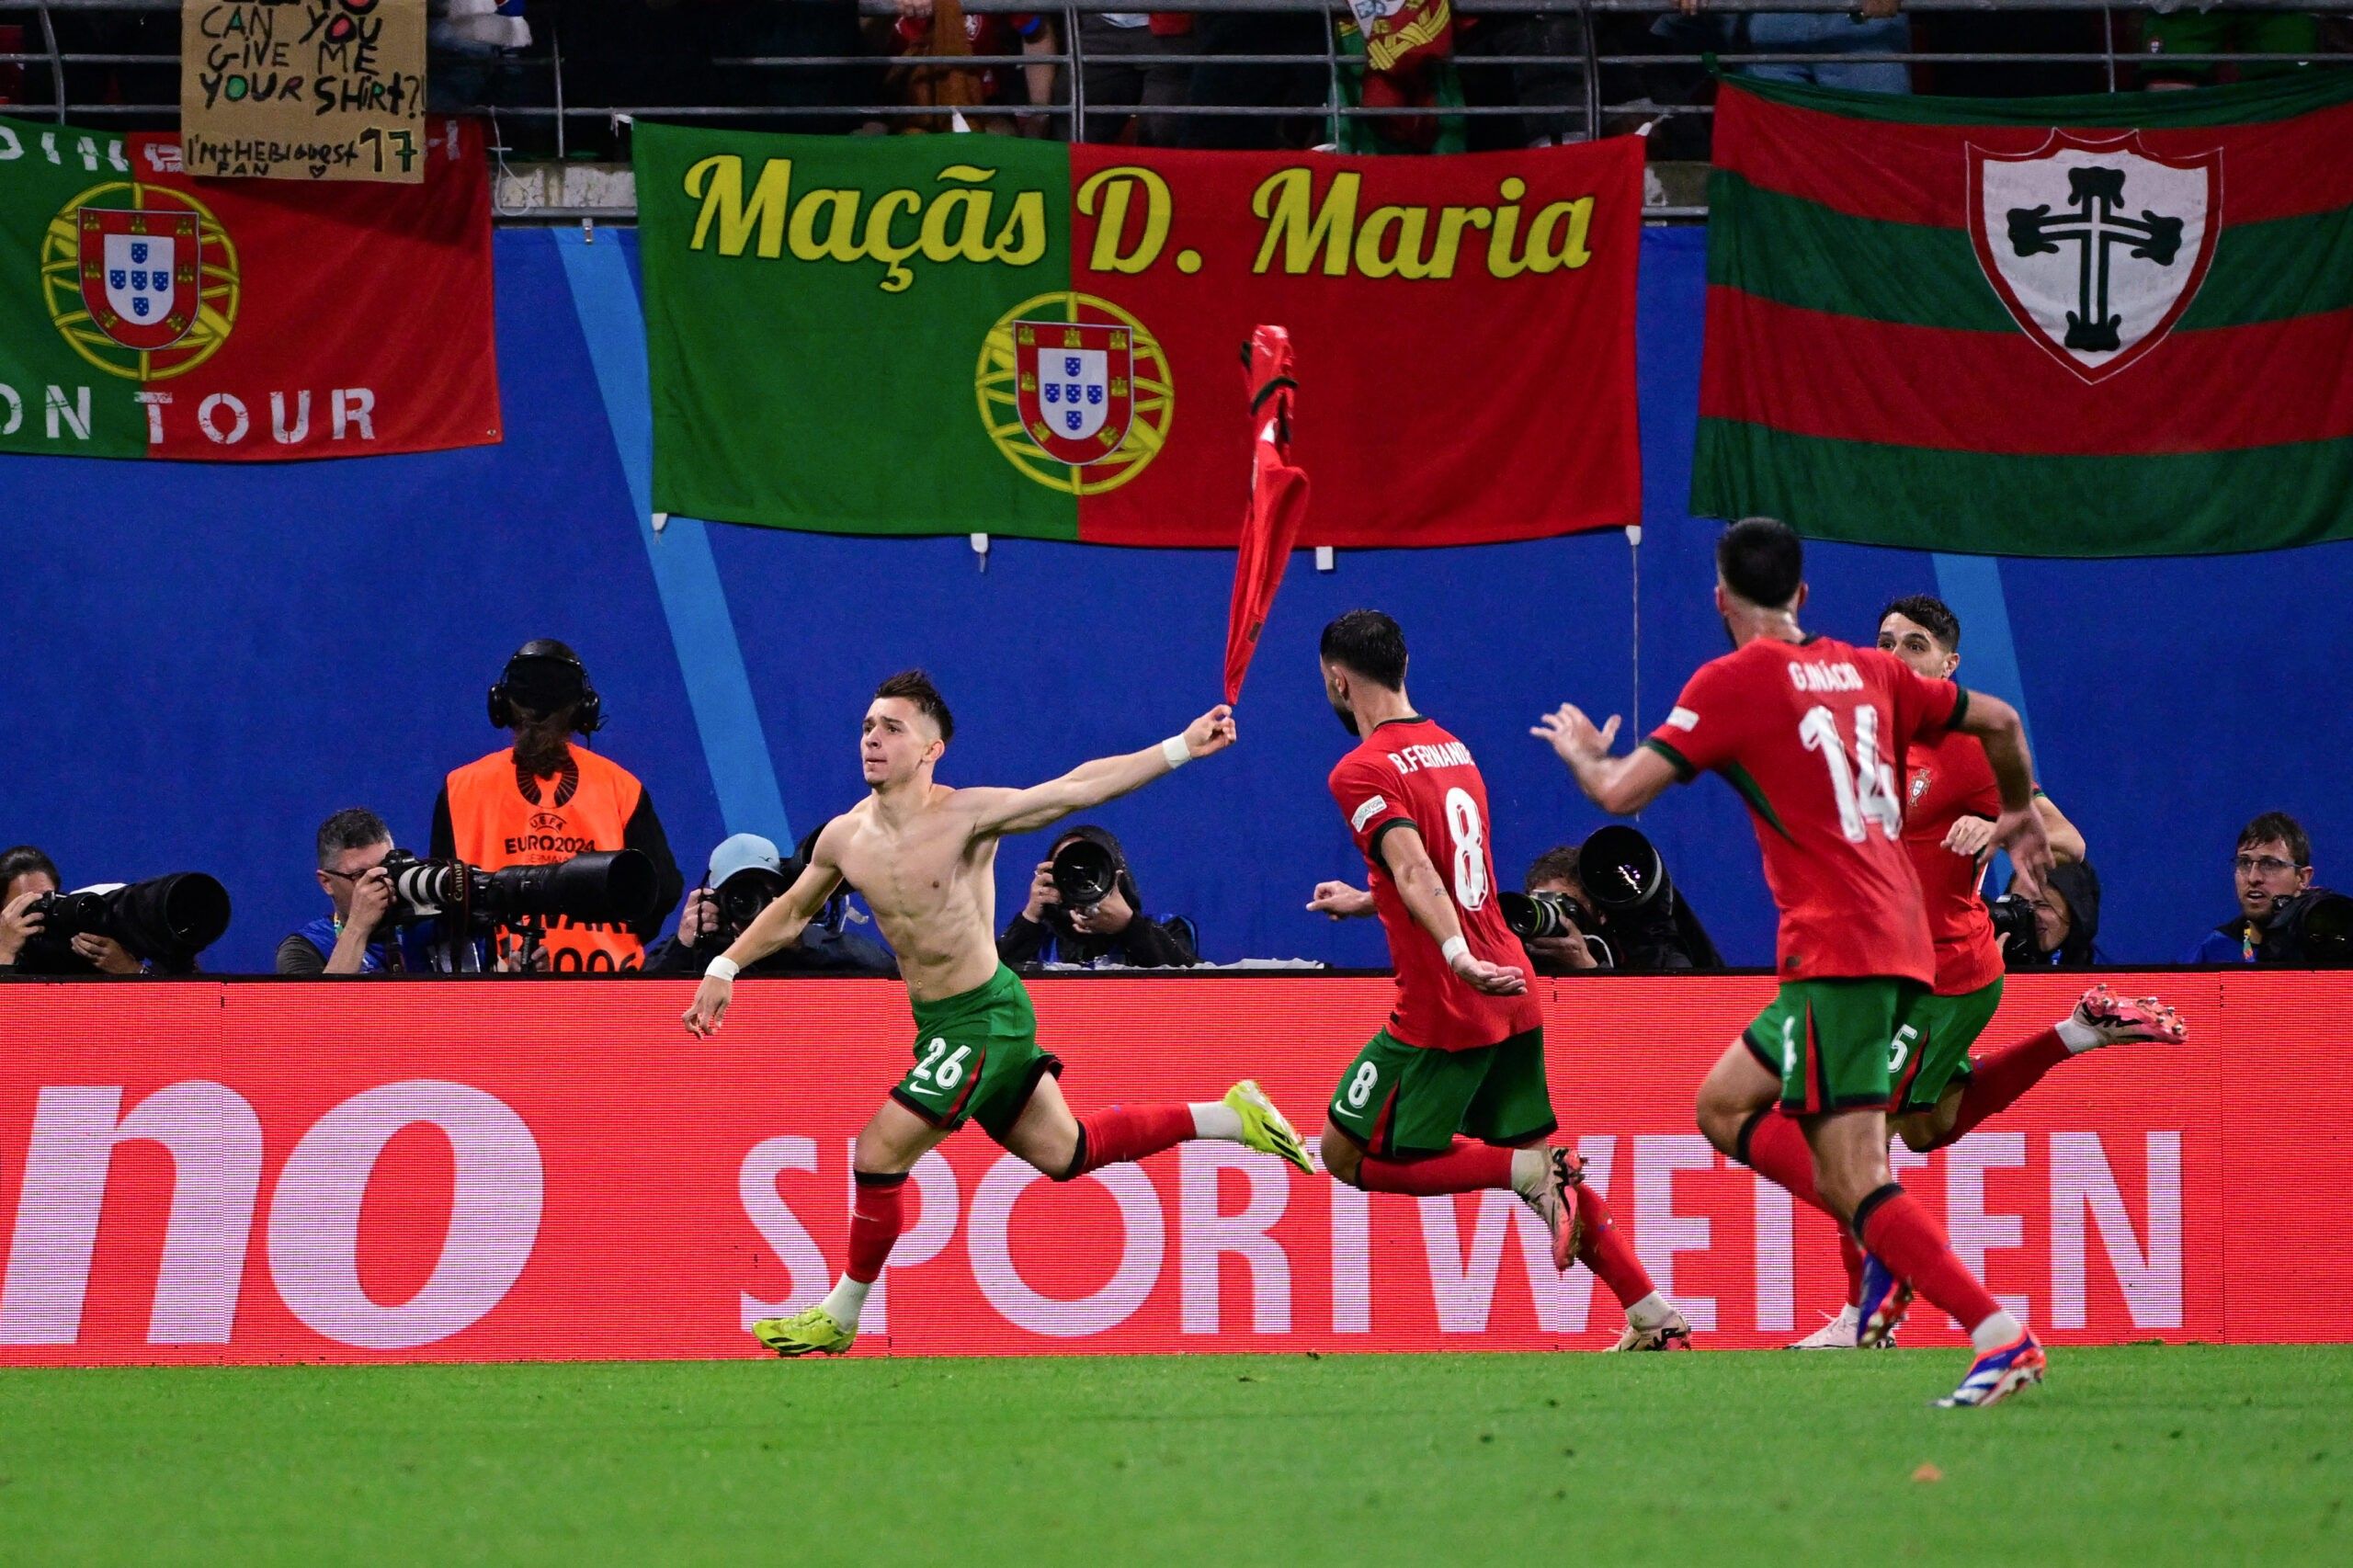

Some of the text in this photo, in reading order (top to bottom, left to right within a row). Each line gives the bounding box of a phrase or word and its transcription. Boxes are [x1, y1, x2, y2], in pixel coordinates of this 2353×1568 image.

[200, 5, 382, 44] CAN YOU
[318, 40, 380, 75] ME
[199, 72, 304, 109] YOUR
[217, 162, 269, 176] FAN
[359, 127, 418, 172] 17
[684, 154, 1594, 292] Maçãs D. Maria
[133, 387, 376, 445] TOUR
[1387, 742, 1476, 775] B.FERNAND
[1799, 703, 1903, 844] 14
[529, 814, 564, 832] UEFA
[504, 835, 596, 856] EURO2024
[1446, 787, 1489, 912] 8
[453, 863, 464, 903] Canon
[913, 1037, 972, 1090] 26
[1347, 1061, 1378, 1109] 8
[0, 1079, 2184, 1348] no SPORTWETEN
